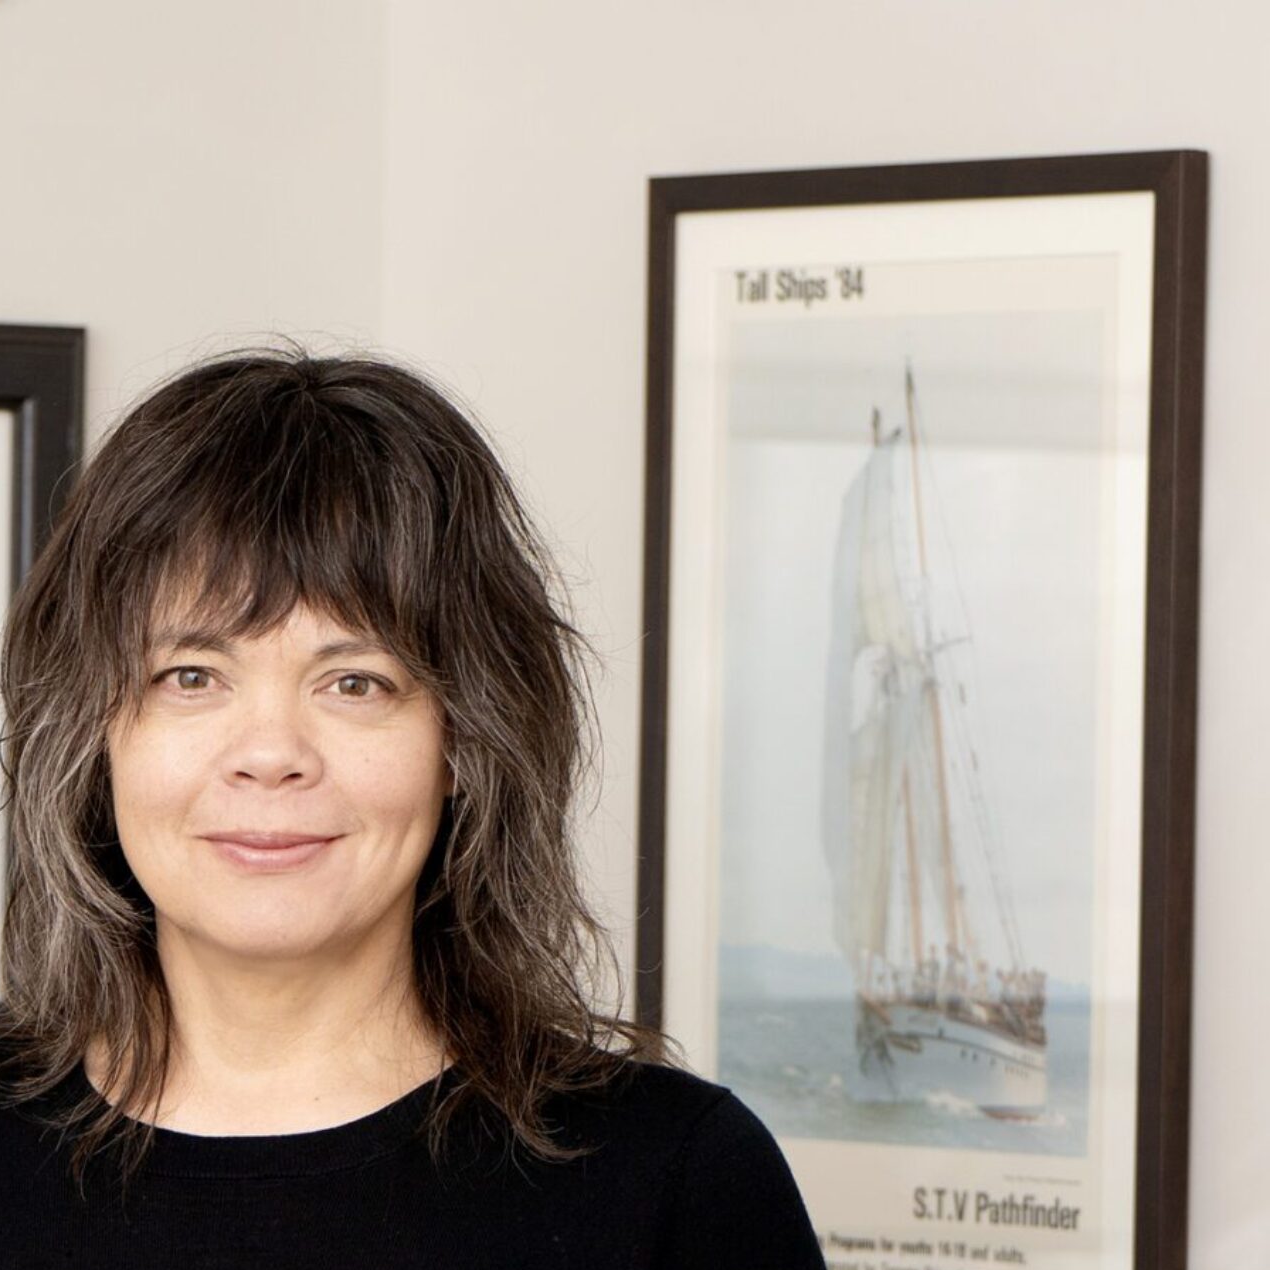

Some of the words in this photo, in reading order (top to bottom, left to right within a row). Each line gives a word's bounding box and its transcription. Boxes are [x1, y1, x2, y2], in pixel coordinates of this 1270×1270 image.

[734, 269, 768, 302] Tall
[776, 267, 828, 309] Ships
[834, 265, 864, 300] '84
[913, 1186, 967, 1222] S.T.V
[975, 1191, 1080, 1230] Pathfinder
[971, 1243, 989, 1260] and
